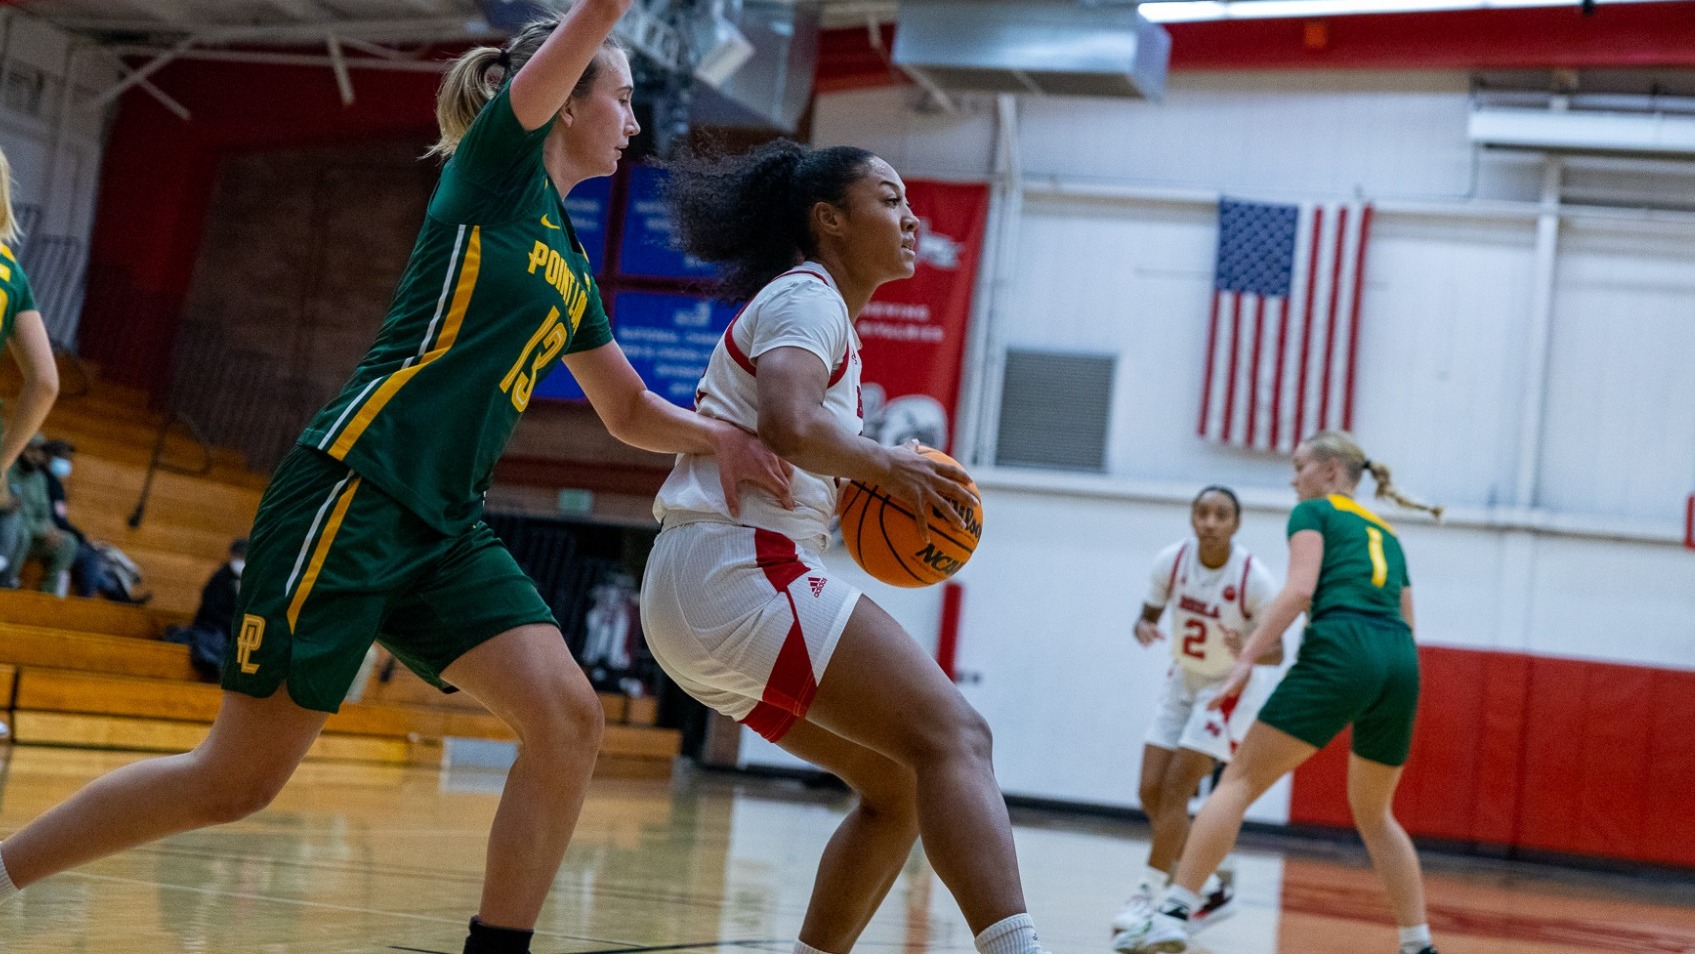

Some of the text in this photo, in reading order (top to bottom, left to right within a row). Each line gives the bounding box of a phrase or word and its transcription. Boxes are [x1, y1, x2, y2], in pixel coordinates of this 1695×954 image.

[528, 240, 575, 306] POINT
[499, 305, 567, 413] 13
[1366, 526, 1388, 588] 1
[1183, 619, 1207, 660] 2
